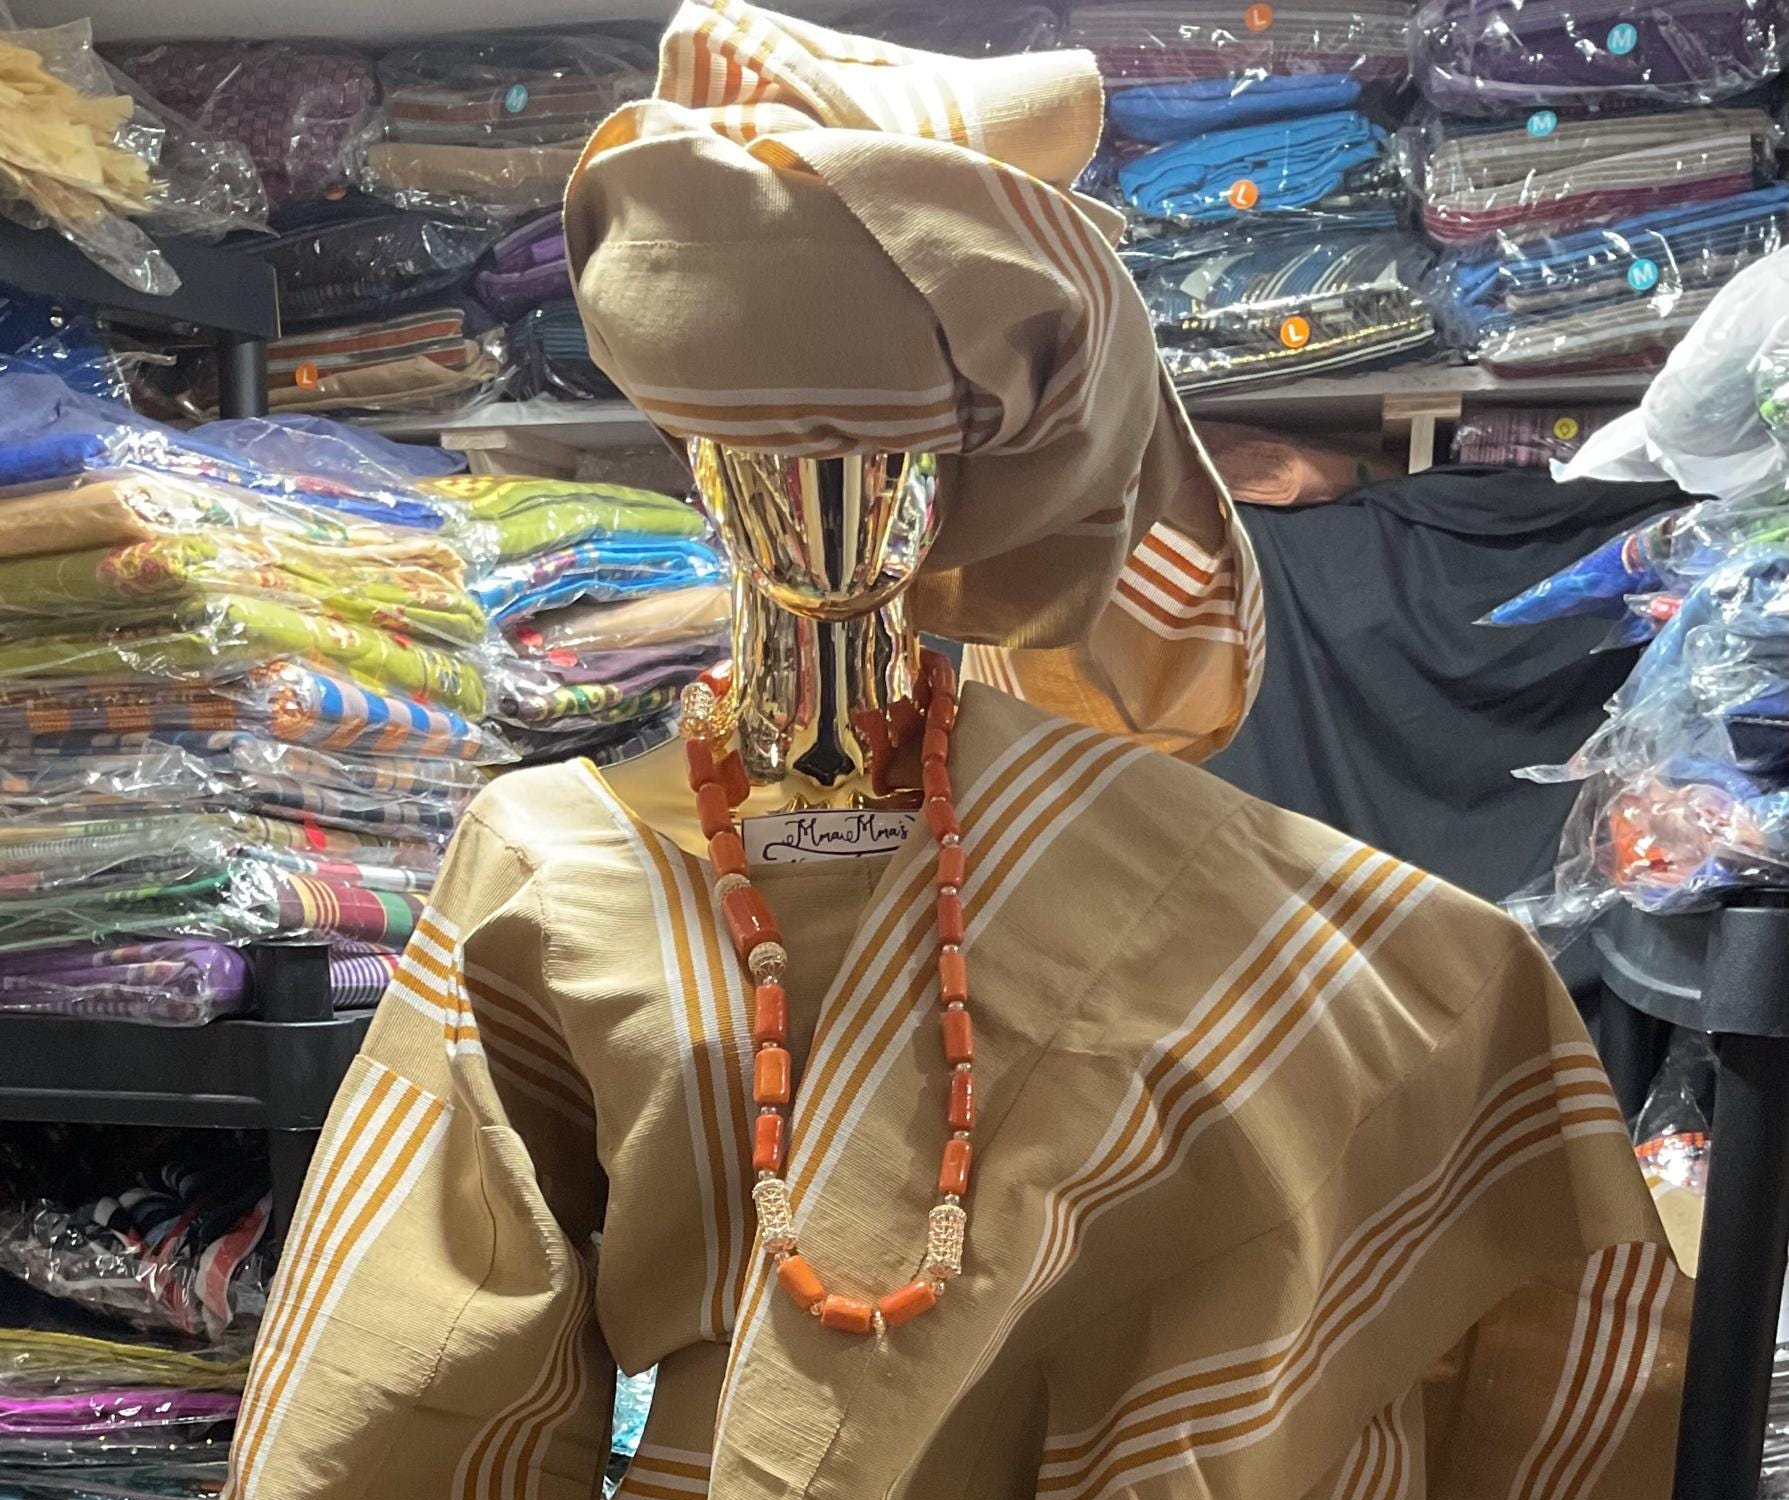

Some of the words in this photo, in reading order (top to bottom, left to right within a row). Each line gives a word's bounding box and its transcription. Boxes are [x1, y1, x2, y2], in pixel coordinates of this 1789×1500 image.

[1612, 28, 1634, 49] M
[1633, 262, 1653, 286] M
[1288, 323, 1304, 342] L
